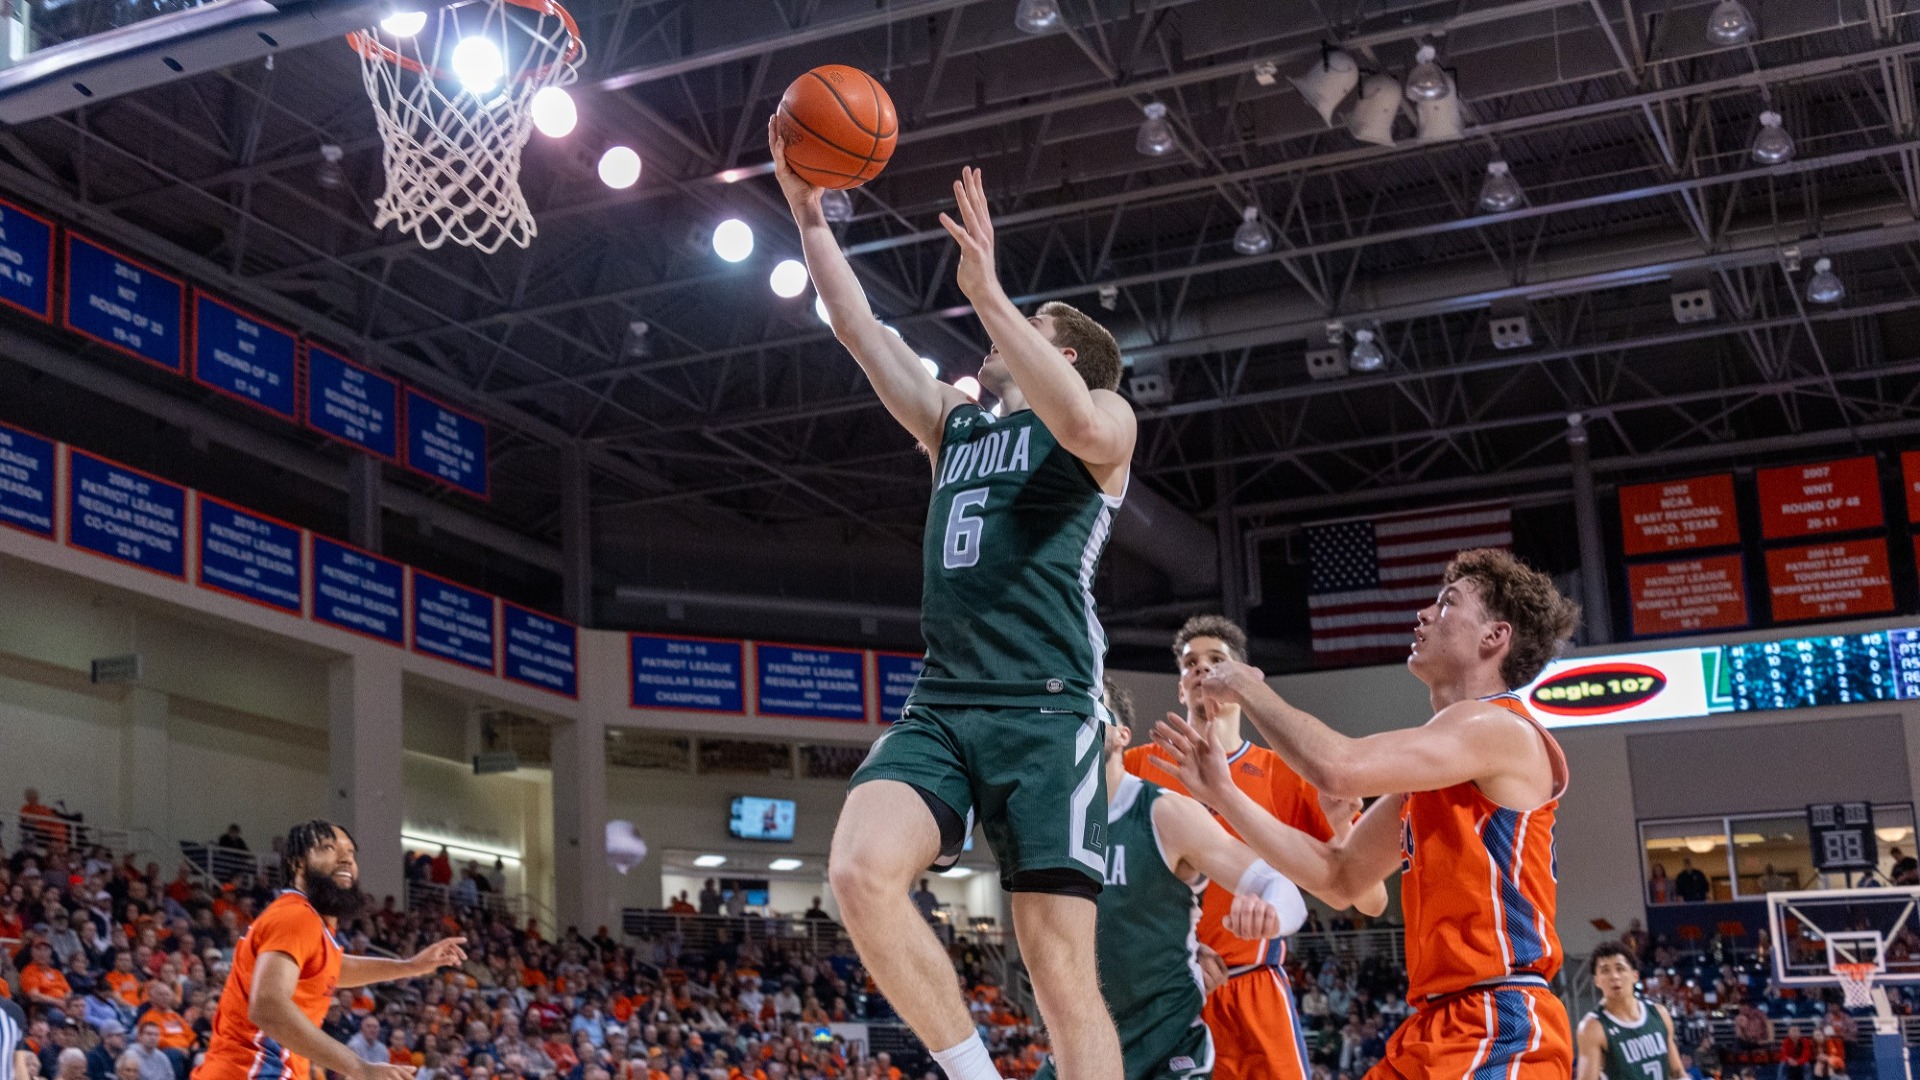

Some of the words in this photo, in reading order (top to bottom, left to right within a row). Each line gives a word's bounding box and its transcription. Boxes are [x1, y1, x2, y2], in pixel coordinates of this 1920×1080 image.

[89, 294, 131, 321] ROUND
[130, 313, 148, 327] OF
[214, 349, 251, 373] ROUND
[250, 365, 265, 378] OF
[938, 426, 1032, 491] LOYOLA
[1803, 466, 1829, 479] 2007
[1802, 482, 1833, 495] WNIT
[81, 479, 128, 503] PATRIOT
[131, 498, 173, 519] LEAGUE
[1660, 496, 1692, 508] NCAA
[1781, 500, 1824, 514] ROUND
[1826, 497, 1843, 509] OF
[78, 495, 131, 521] REGULAR
[133, 514, 178, 537] SEASON
[1634, 512, 1662, 524] EAST
[1664, 506, 1721, 520] REGIONAL
[1807, 516, 1837, 528] 20-11
[84, 514, 171, 551] CO-CHAMPIONS
[943, 487, 990, 570] 6
[1682, 518, 1718, 530] TEXAS
[210, 523, 251, 544] PATRIOT
[253, 539, 292, 559] LEAGUE
[207, 538, 254, 562] REGULAR
[255, 555, 294, 575] SEASON
[1785, 559, 1827, 571] PATRIOT
[1829, 555, 1869, 567] LEAGUE
[1794, 566, 1863, 581] TOURNAMENT
[1821, 576, 1887, 590] BASKETBALL
[1800, 589, 1862, 603] CHAMPIONS
[641, 657, 686, 668] PATRIOT
[689, 661, 731, 673] LEAGUE
[1734, 659, 1744, 670] 2
[1768, 656, 1781, 666] 10
[1800, 653, 1813, 664] 10
[1835, 650, 1844, 661] 5
[1901, 657, 1920, 670] AS
[767, 663, 810, 675] PATRIOT
[813, 667, 854, 678] LEAGUE
[1736, 672, 1745, 683] 0
[1770, 669, 1780, 680] 0
[1803, 667, 1813, 677] 4
[1837, 663, 1846, 675] 3
[1869, 659, 1880, 672] 0
[1903, 670, 1920, 683] RE
[638, 673, 689, 685] REGULAR
[692, 677, 735, 689] SEASON
[764, 676, 814, 688] REGULAR
[816, 680, 858, 691] SEASON
[1536, 681, 1605, 701] eagle
[1607, 676, 1655, 694] 107
[1738, 685, 1747, 696] 5
[1772, 682, 1782, 694] 5
[1805, 679, 1815, 691] 5
[1838, 676, 1848, 688] 2
[1871, 673, 1882, 685] 0
[656, 691, 720, 704] CHAMPIONS
[1739, 699, 1749, 710] 3
[1876, 687, 1884, 699] 1
[1619, 1032, 1667, 1064] LOYOLA
[1642, 1060, 1664, 1080] 7
